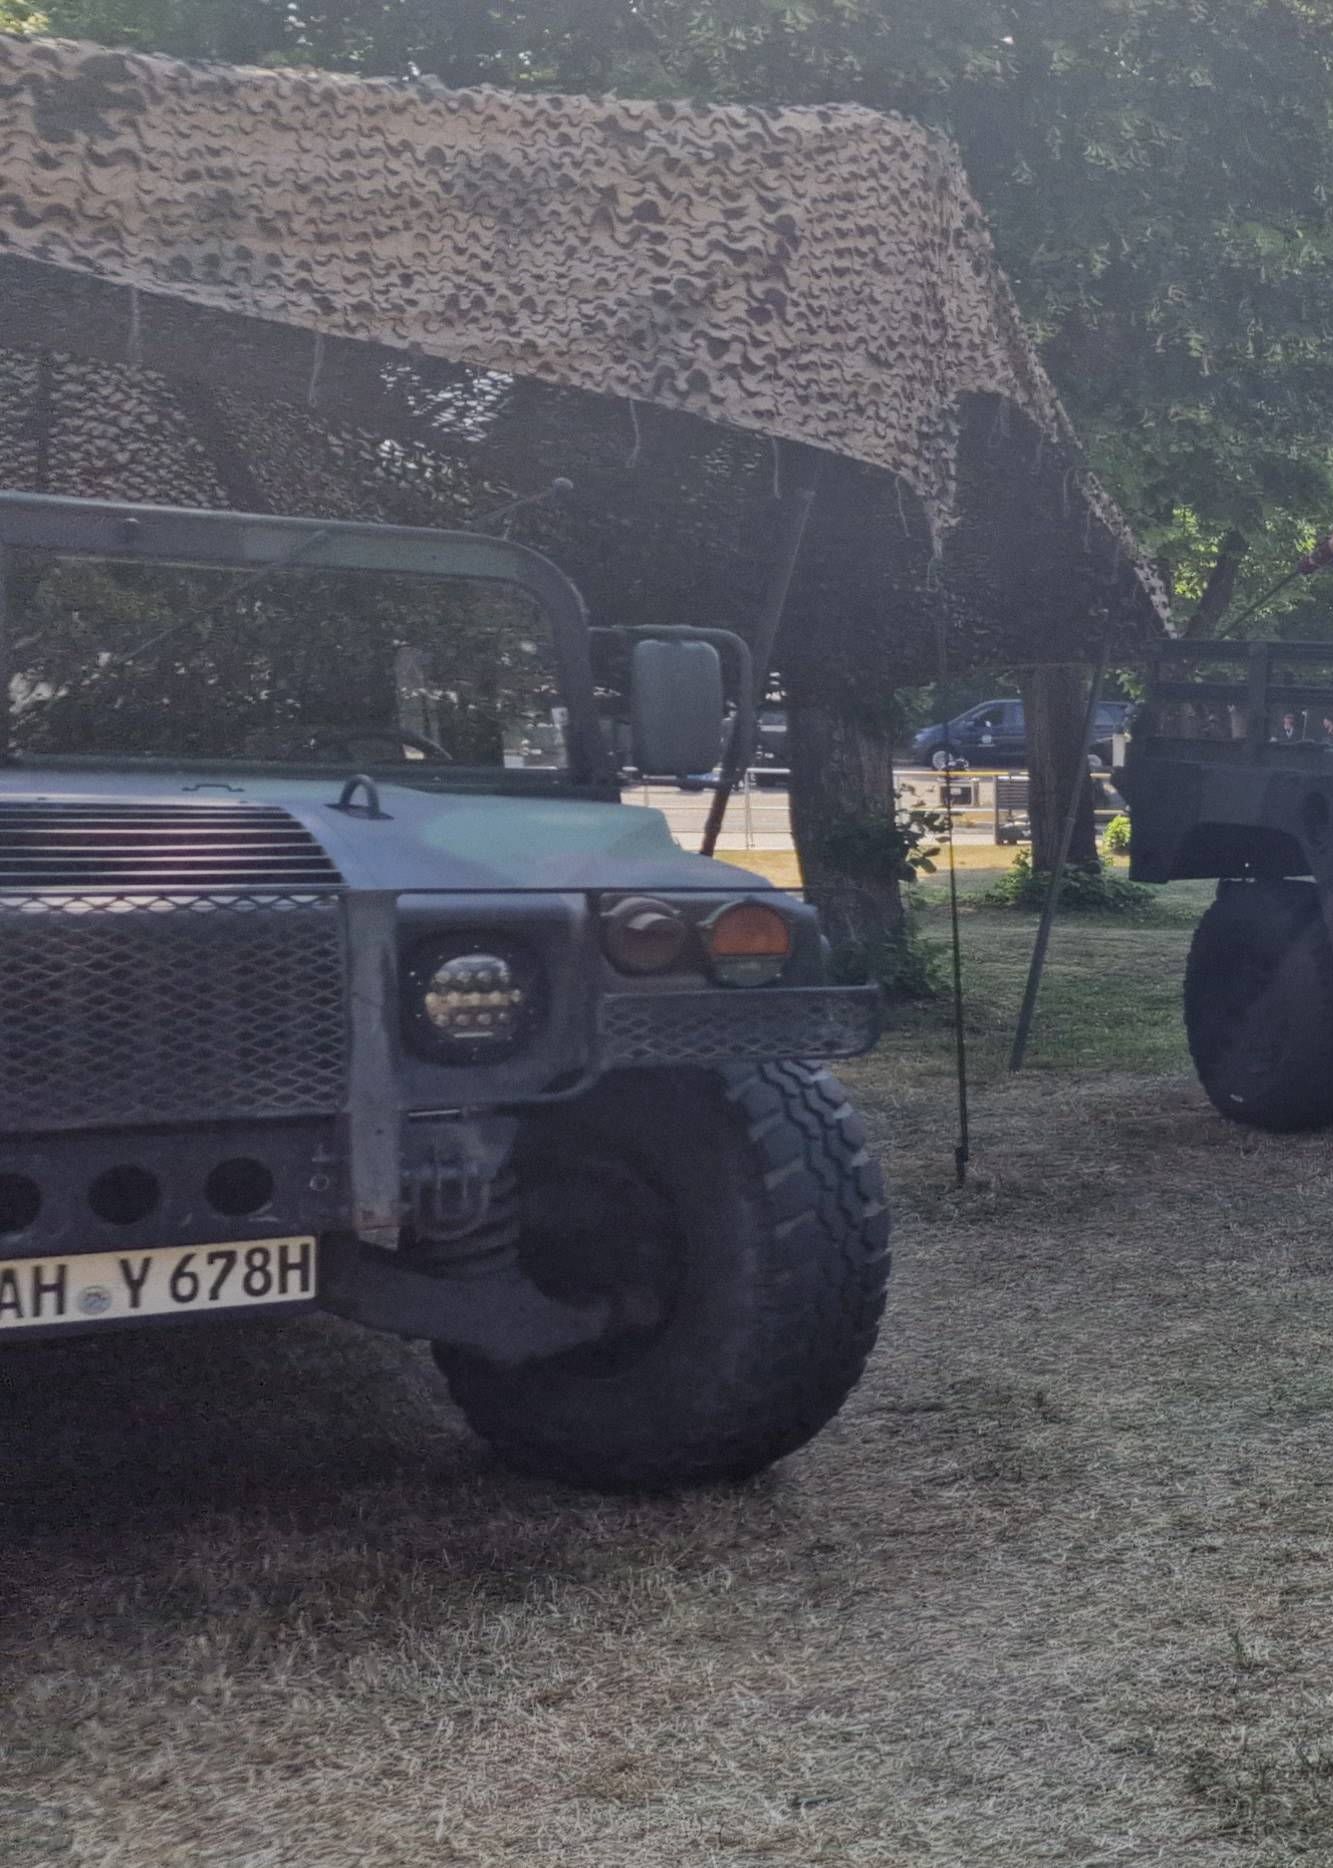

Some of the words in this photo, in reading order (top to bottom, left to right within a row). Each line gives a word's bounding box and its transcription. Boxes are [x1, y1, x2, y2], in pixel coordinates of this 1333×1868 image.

[0, 1264, 68, 1319] AH
[119, 1256, 152, 1309] Y
[169, 1243, 311, 1304] 678H
